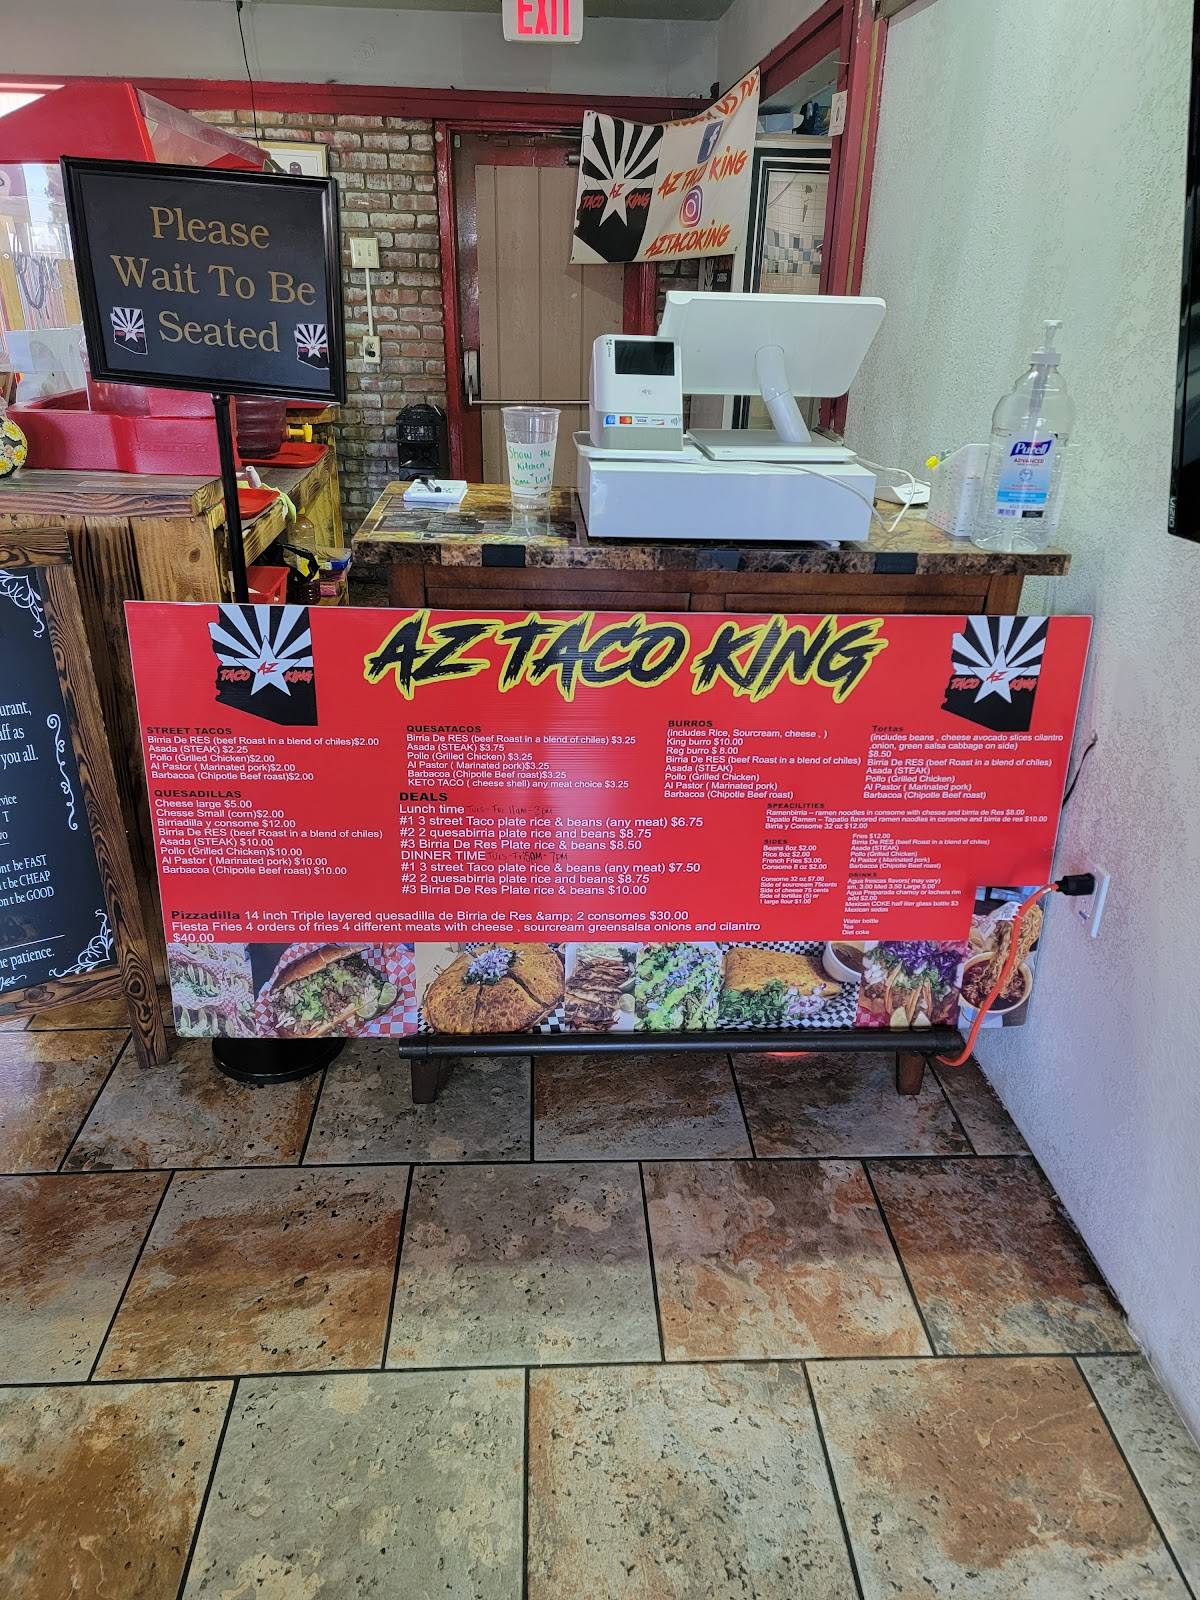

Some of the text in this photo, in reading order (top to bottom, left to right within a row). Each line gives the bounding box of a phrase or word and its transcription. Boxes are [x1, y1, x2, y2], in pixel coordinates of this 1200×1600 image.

[658, 171, 684, 199] AZ
[708, 146, 748, 183] KING
[609, 183, 623, 200] AZ
[582, 192, 651, 209] TACO KING
[150, 206, 271, 249] Please
[645, 219, 731, 258] AZTACOKING
[109, 255, 317, 305] Wait To Be
[158, 310, 281, 353] Seated
[509, 446, 551, 460] Show the
[1015, 441, 1049, 455] Purell
[1169, 496, 1177, 528] VIZIO
[365, 609, 889, 703] AZ TACO KING
[257, 661, 279, 675] AZ
[219, 669, 313, 684] TACO KING
[986, 670, 1008, 685] AZ
[951, 677, 980, 691] TACO
[13, 727, 24, 739] as
[667, 738, 685, 746] King
[714, 738, 742, 746] $10.00
[180, 745, 219, 754] (STEAK)
[222, 745, 247, 753] $2.25
[0, 744, 39, 770] you all.
[150, 753, 274, 763] Pollo (Grilled Chicken)$2.00
[154, 789, 240, 797] QUESADILLAS
[400, 792, 447, 801] DEALS
[155, 799, 251, 809] Cheese large $5.00
[400, 804, 434, 813] Lunch
[439, 804, 463, 813] time
[400, 816, 702, 828] #1 3 street Taco plate rice & beans (any meat) $6.75
[400, 828, 650, 839] #2 2 quesabirria plate rice and beans $8.75
[400, 839, 641, 850] #3 Birria De Res Plate rice & beans $8.50
[401, 850, 450, 859] DINNER
[455, 851, 485, 860] TIME
[13, 854, 47, 871] be FAST
[19, 870, 51, 887] CHEAP
[26, 886, 55, 902] GOOD
[171, 911, 239, 919] Pizzadilla
[245, 911, 258, 919] 14
[263, 911, 287, 919] inch
[291, 911, 323, 921] Triple
[328, 911, 370, 921] layered
[375, 911, 434, 921] quesadilla
[439, 911, 452, 920] de
[457, 911, 486, 920] Birria
[491, 911, 505, 920] de
[510, 911, 531, 920] Res
[536, 911, 572, 922] &amp;
[577, 912, 583, 920] 2
[649, 911, 687, 920] $30.00
[172, 922, 208, 931] Fiesta
[212, 922, 242, 931] Fries
[246, 922, 253, 930] 4
[257, 922, 294, 931] orders
[299, 922, 309, 930] of
[313, 922, 338, 931] fries
[342, 922, 349, 930] 4
[354, 922, 401, 931] different
[405, 922, 440, 931] meats
[444, 922, 467, 930] with
[471, 922, 512, 931] cheese
[524, 921, 583, 931] sourcream
[588, 922, 649, 932] greensalsa
[654, 922, 691, 930] onions
[695, 922, 715, 930] and
[720, 921, 759, 930] cilantro
[172, 933, 216, 942] $40.00
[9, 946, 55, 970] patience.
